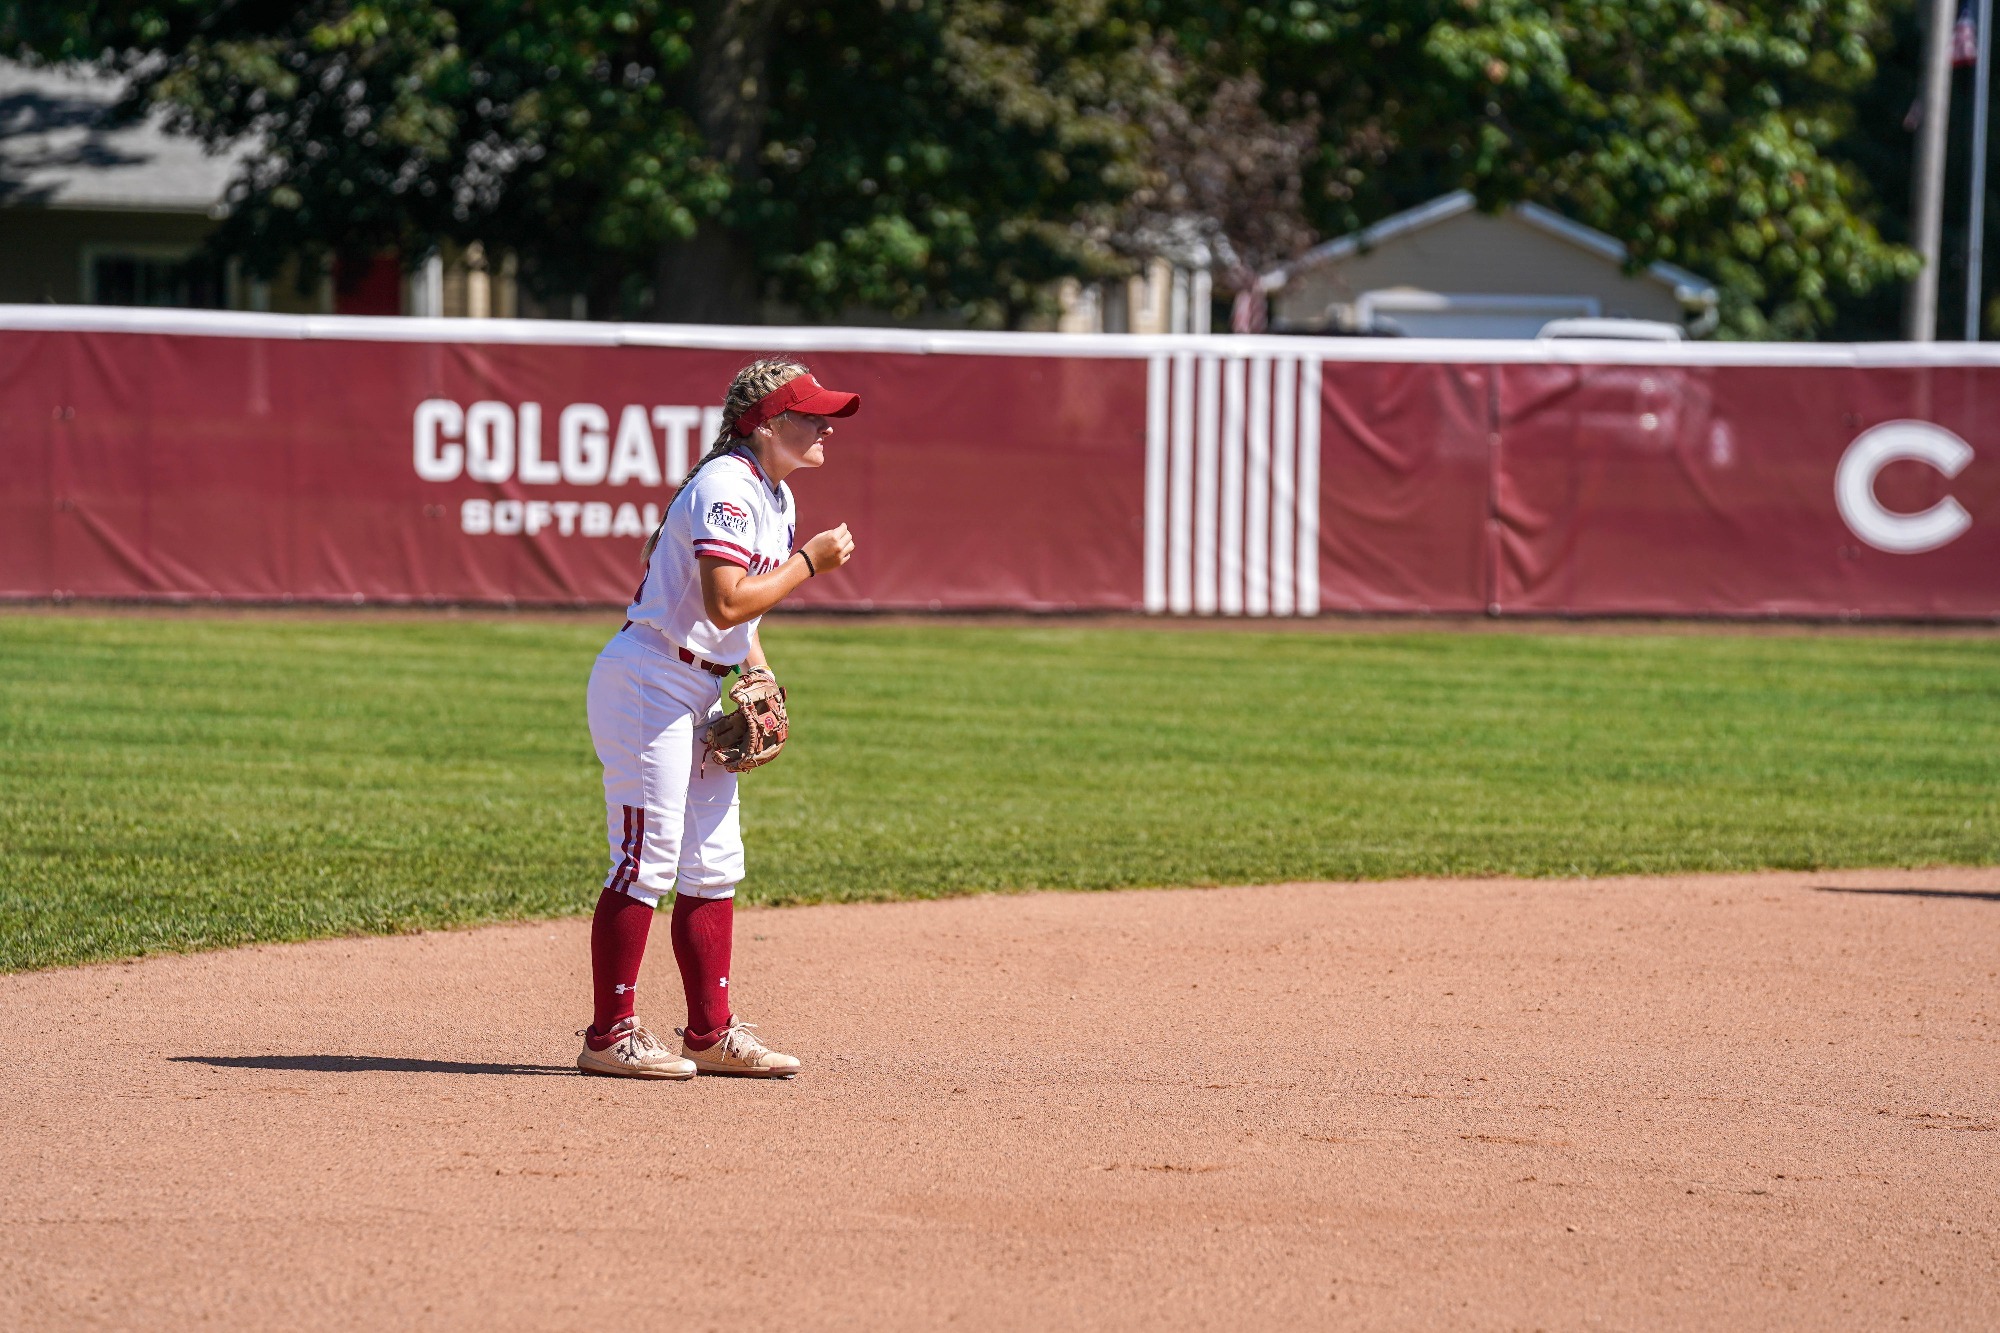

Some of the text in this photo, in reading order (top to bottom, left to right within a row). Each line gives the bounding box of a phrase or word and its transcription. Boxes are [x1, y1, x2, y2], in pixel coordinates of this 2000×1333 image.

[1834, 418, 1975, 555] C
[461, 499, 663, 538] SOFTBAL
[706, 518, 747, 534] LEAGUE
[707, 512, 749, 527] PATRIOT
